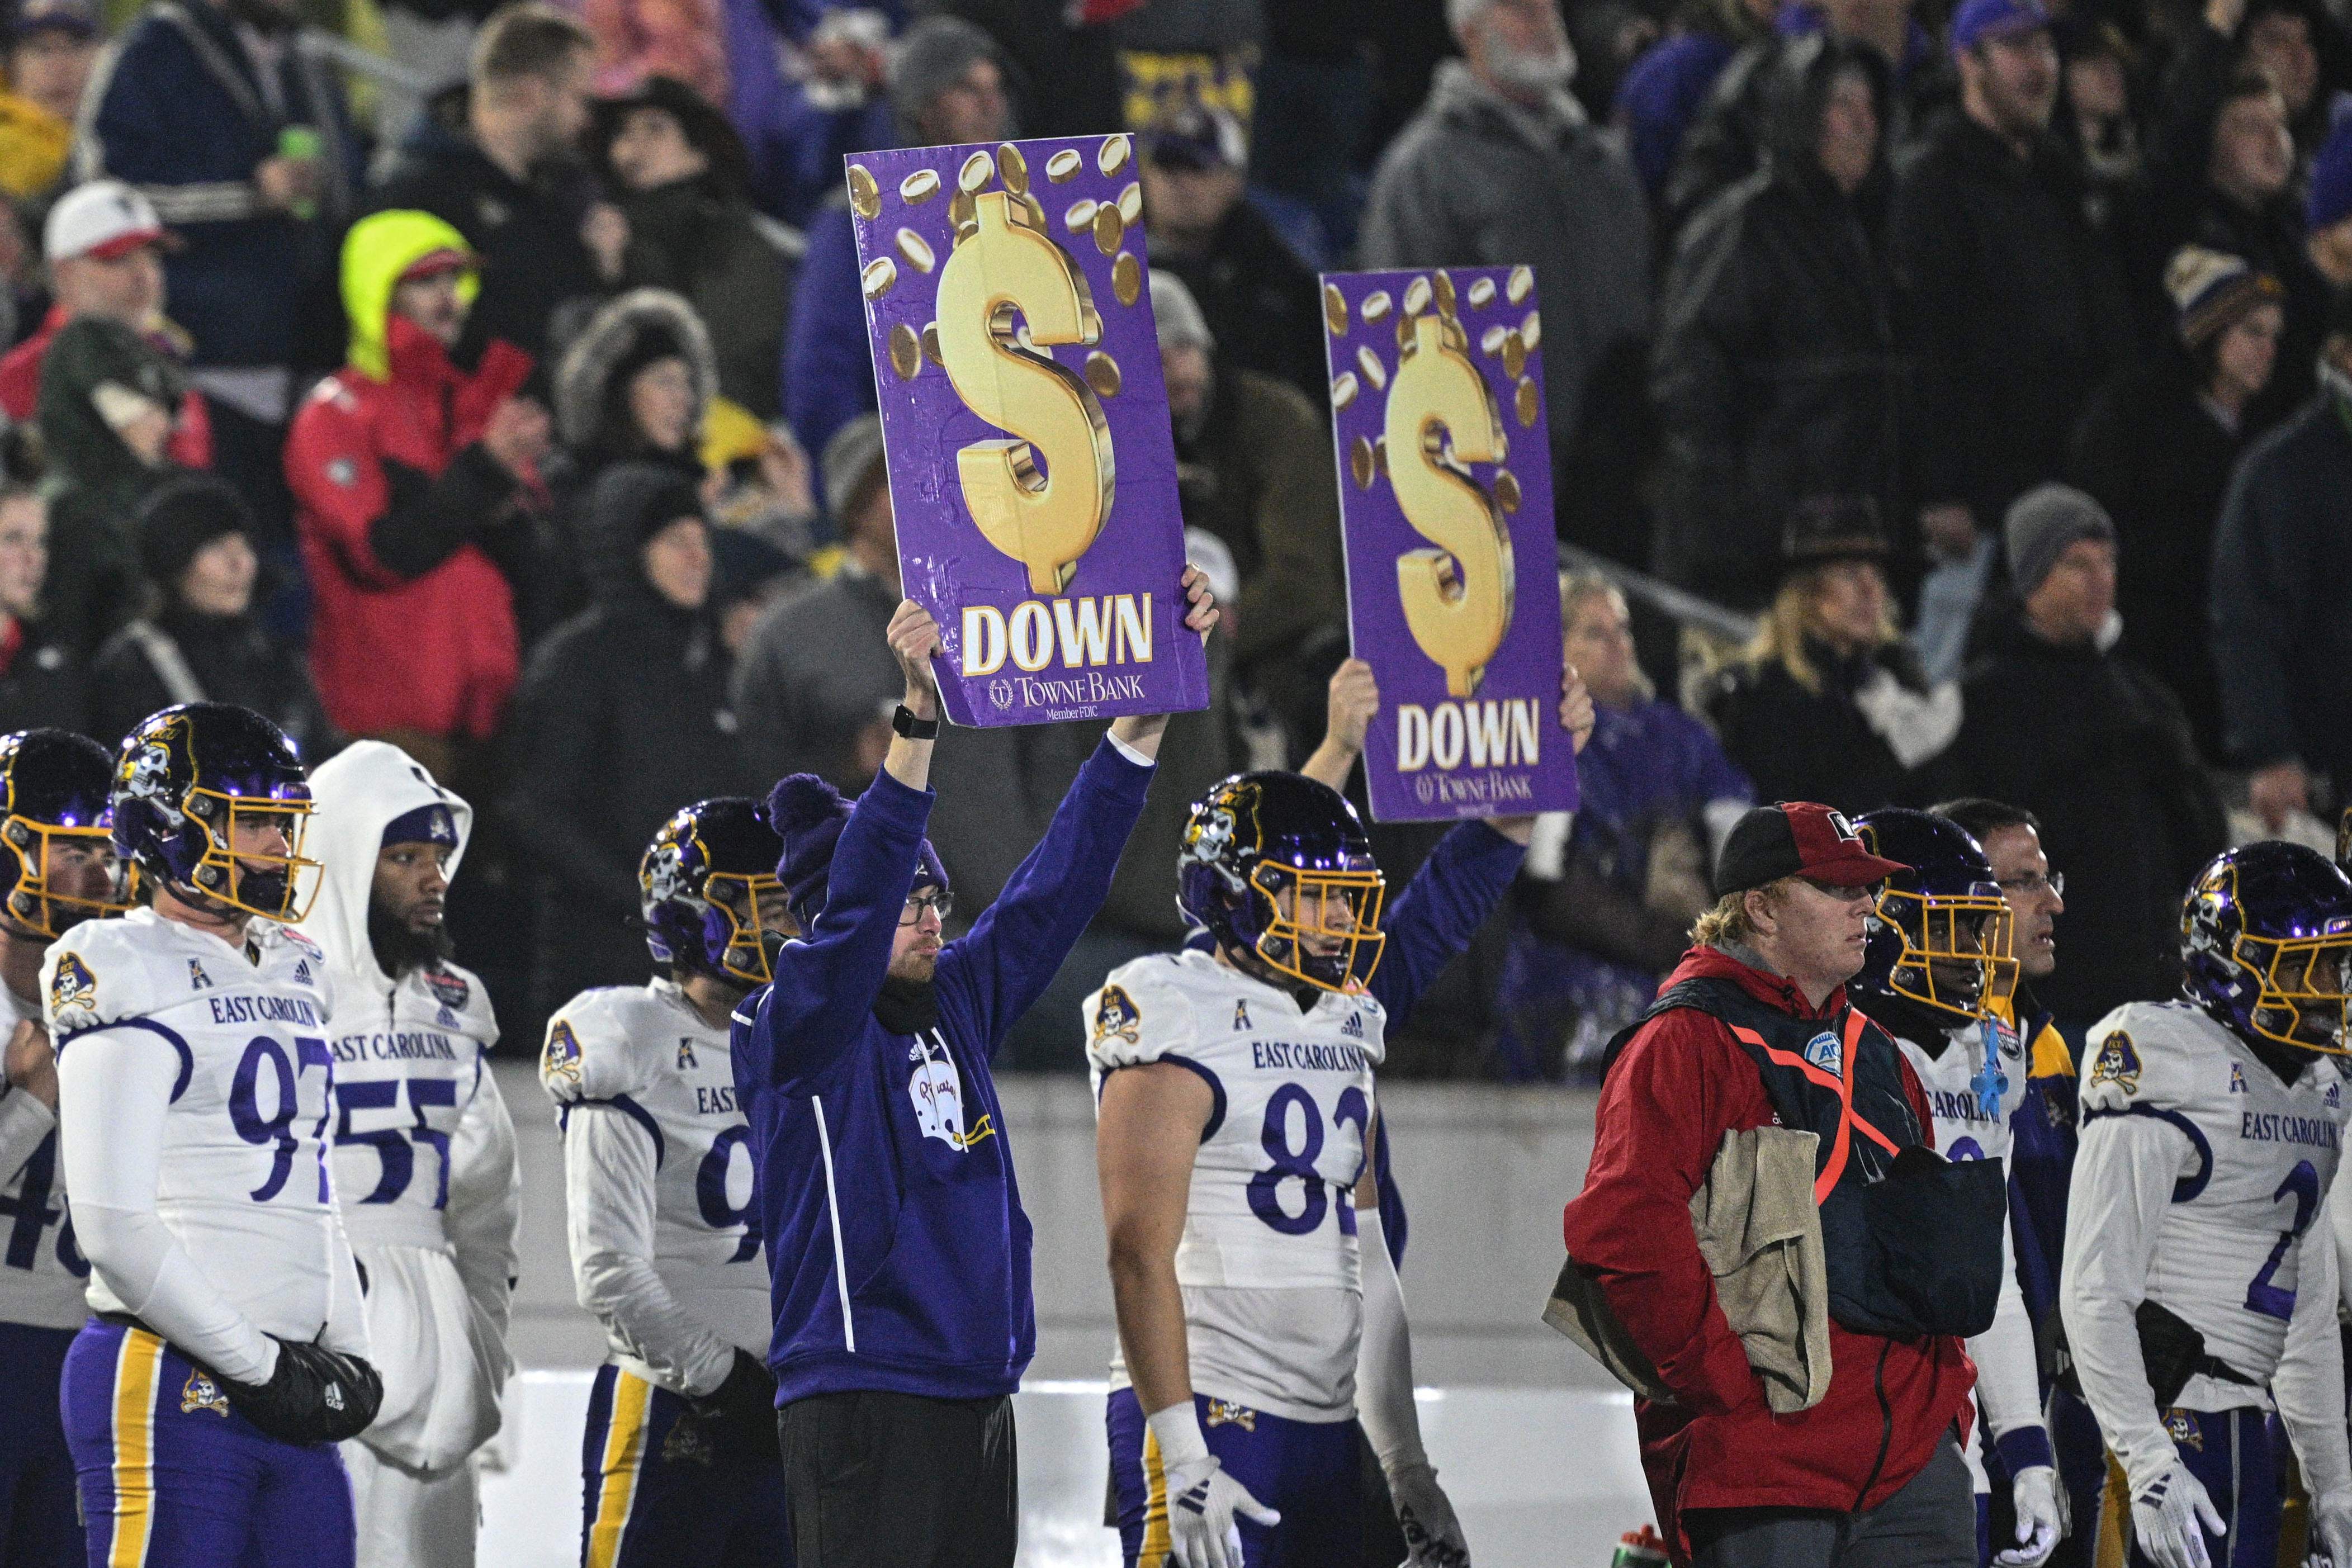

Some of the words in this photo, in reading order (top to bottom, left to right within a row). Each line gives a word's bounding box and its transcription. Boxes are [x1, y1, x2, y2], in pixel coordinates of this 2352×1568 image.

[962, 593, 1153, 677] DOWN
[1046, 708, 1080, 721] Member
[1080, 705, 1098, 718] FDIC
[1398, 697, 1540, 772] DOWN
[209, 996, 257, 1024] EAST
[257, 996, 318, 1028] CAROLIN
[331, 1035, 367, 1062] AST
[1252, 1041, 1293, 1069] EAST
[229, 1036, 334, 1205] 97
[334, 1078, 457, 1211] 55
[2241, 1111, 2280, 1142] EAST
[2282, 1115, 2338, 1150] CAROLIN
[1247, 1082, 1368, 1237] 82
[2243, 1159, 2320, 1323] 2
